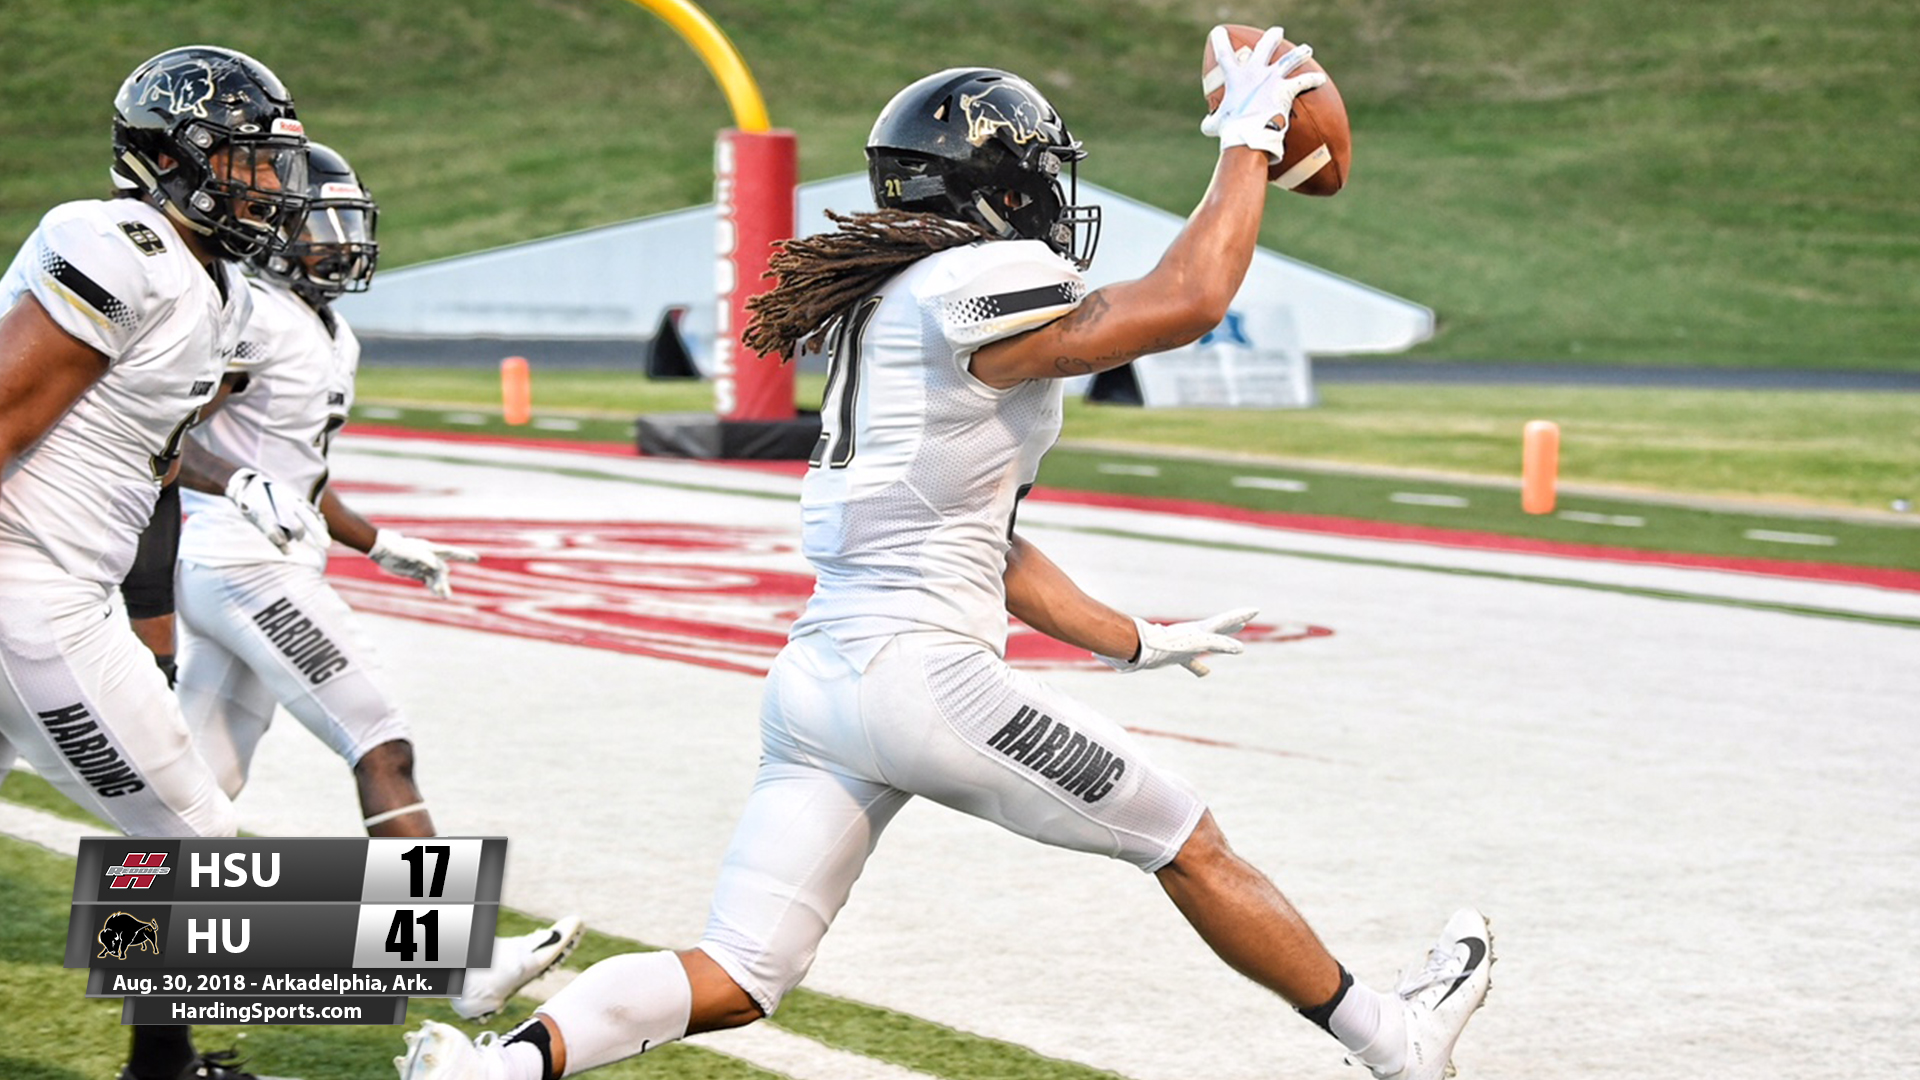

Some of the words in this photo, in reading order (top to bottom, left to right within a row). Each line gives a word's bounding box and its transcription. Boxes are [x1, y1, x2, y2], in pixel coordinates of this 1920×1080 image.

[885, 179, 902, 197] 21
[252, 597, 349, 685] HARDING
[37, 702, 146, 798] HARDING
[986, 704, 1125, 804] HARDING
